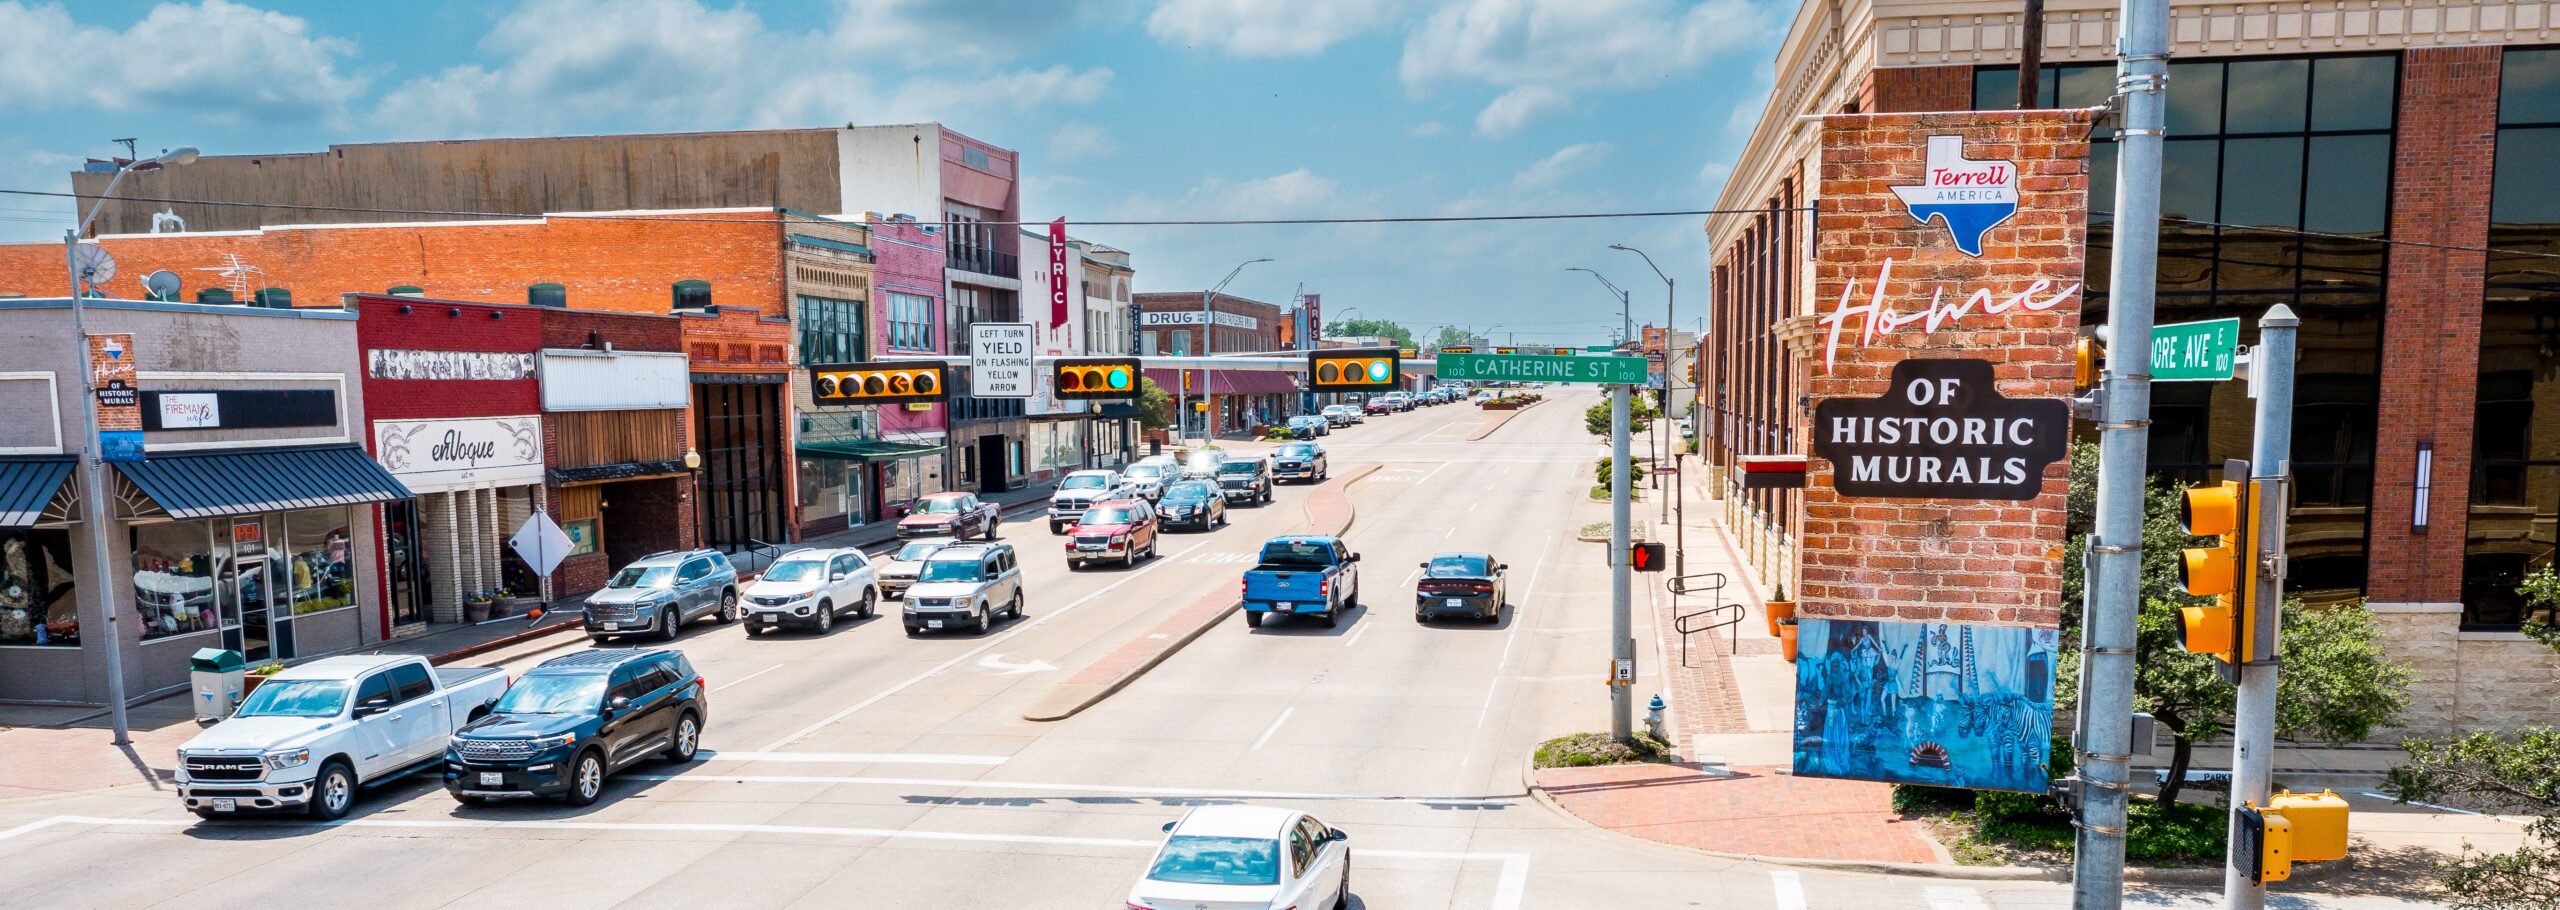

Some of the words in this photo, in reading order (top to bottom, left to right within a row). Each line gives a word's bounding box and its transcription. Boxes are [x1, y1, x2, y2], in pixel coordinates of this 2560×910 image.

[1933, 166, 2009, 186] Terrell
[1937, 190, 2002, 200] AMERICA
[1052, 234, 1064, 304] LYRIC
[1149, 313, 1192, 324] DRUG
[1311, 299, 1319, 339] IRIS
[1818, 257, 2080, 376] Home
[980, 330, 998, 338] LEFT
[1004, 330, 1024, 338] TURN
[2217, 327, 2224, 346] E
[983, 343, 1022, 354] YIELD
[2151, 336, 2177, 368] ORE
[2184, 333, 2211, 368] AVE
[991, 359, 1029, 367] FLASHING
[1460, 357, 1465, 365] S
[1475, 359, 1575, 377] CATHERINE
[1588, 361, 1611, 377] ST
[1620, 360, 1626, 369] N
[2215, 353, 2229, 372] 100
[988, 371, 1018, 379] YELLOW
[1448, 368, 1465, 376] 100
[1619, 372, 1635, 380] 100
[1906, 377, 1961, 406] OF
[1831, 416, 2035, 446] HISTORIC
[432, 429, 494, 467] enVogue
[1851, 455, 2027, 484] MURALS
[243, 544, 255, 554] 101
